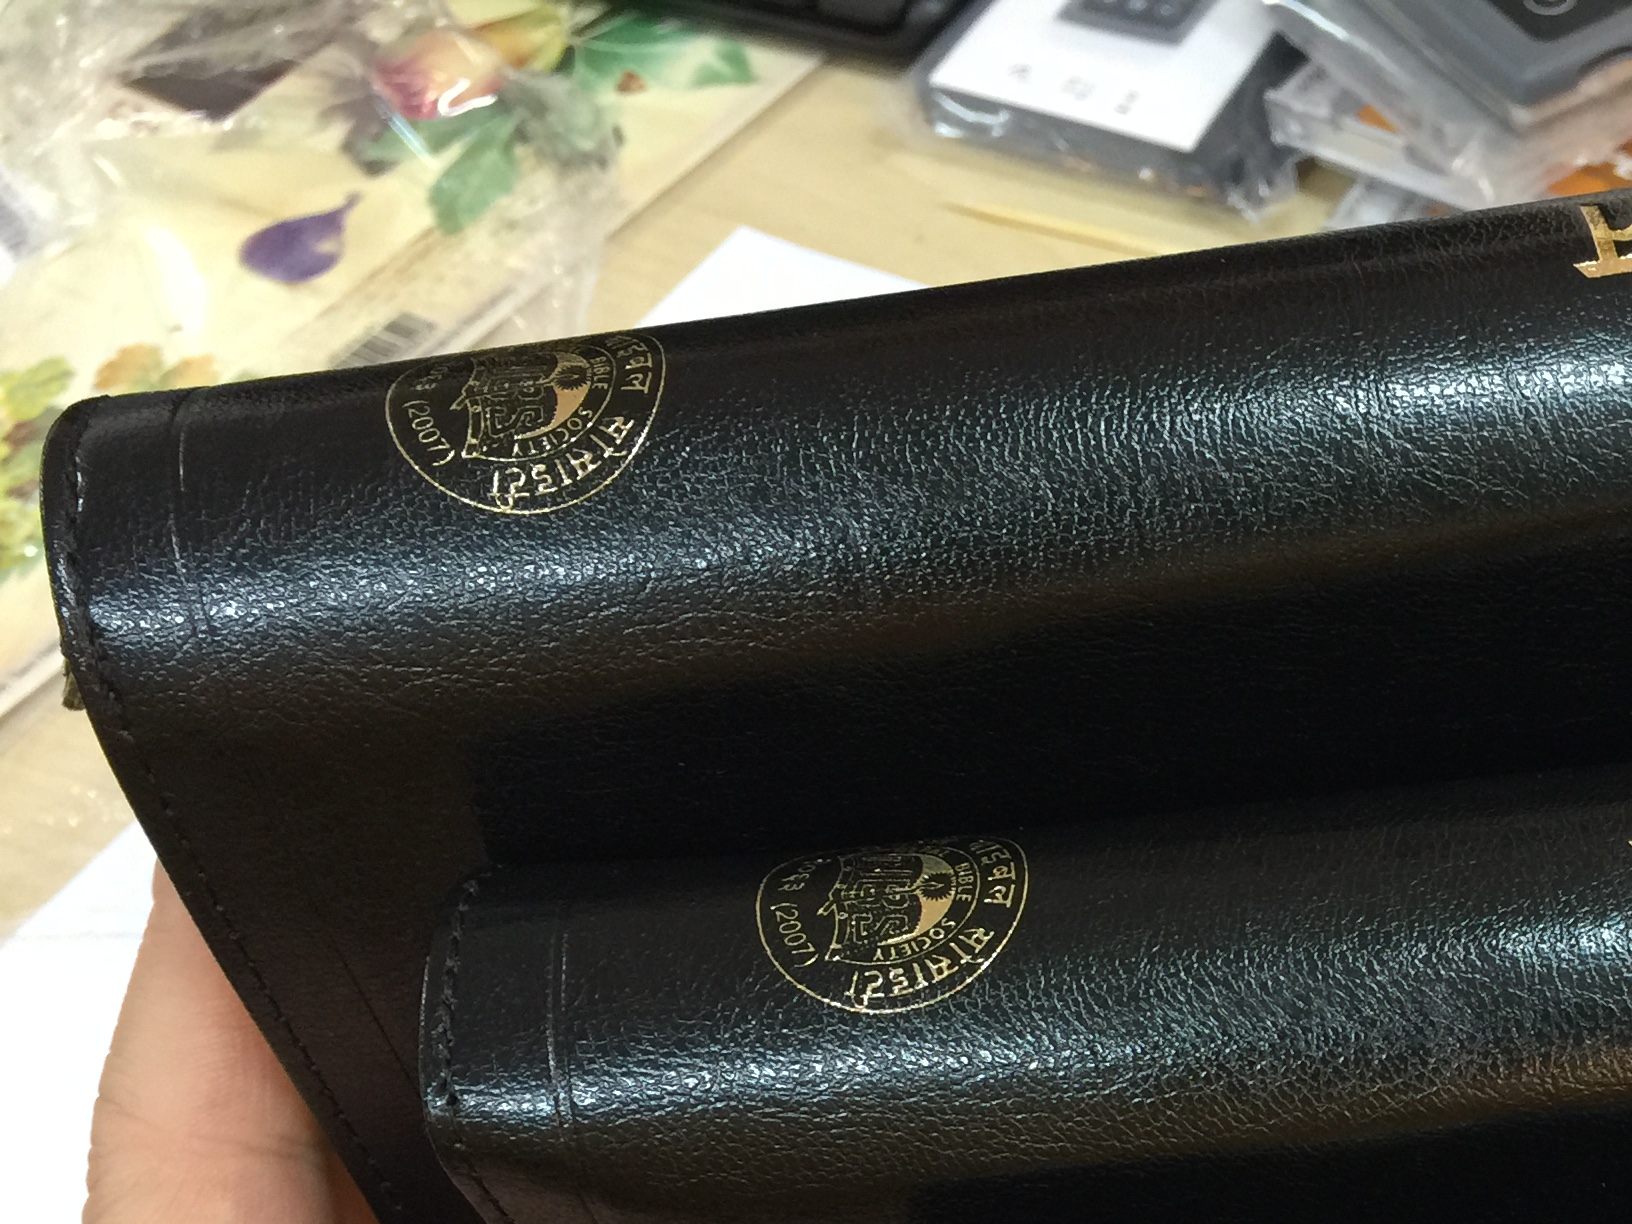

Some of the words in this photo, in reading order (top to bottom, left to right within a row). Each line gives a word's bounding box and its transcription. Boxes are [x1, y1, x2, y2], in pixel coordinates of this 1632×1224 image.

[590, 355, 609, 391] BIBLE
[402, 400, 456, 468] (2007)
[512, 406, 593, 457] SOCIETY
[955, 862, 971, 903] BIBLE
[769, 902, 819, 969] (2007)
[872, 917, 957, 962] SOCIETY
